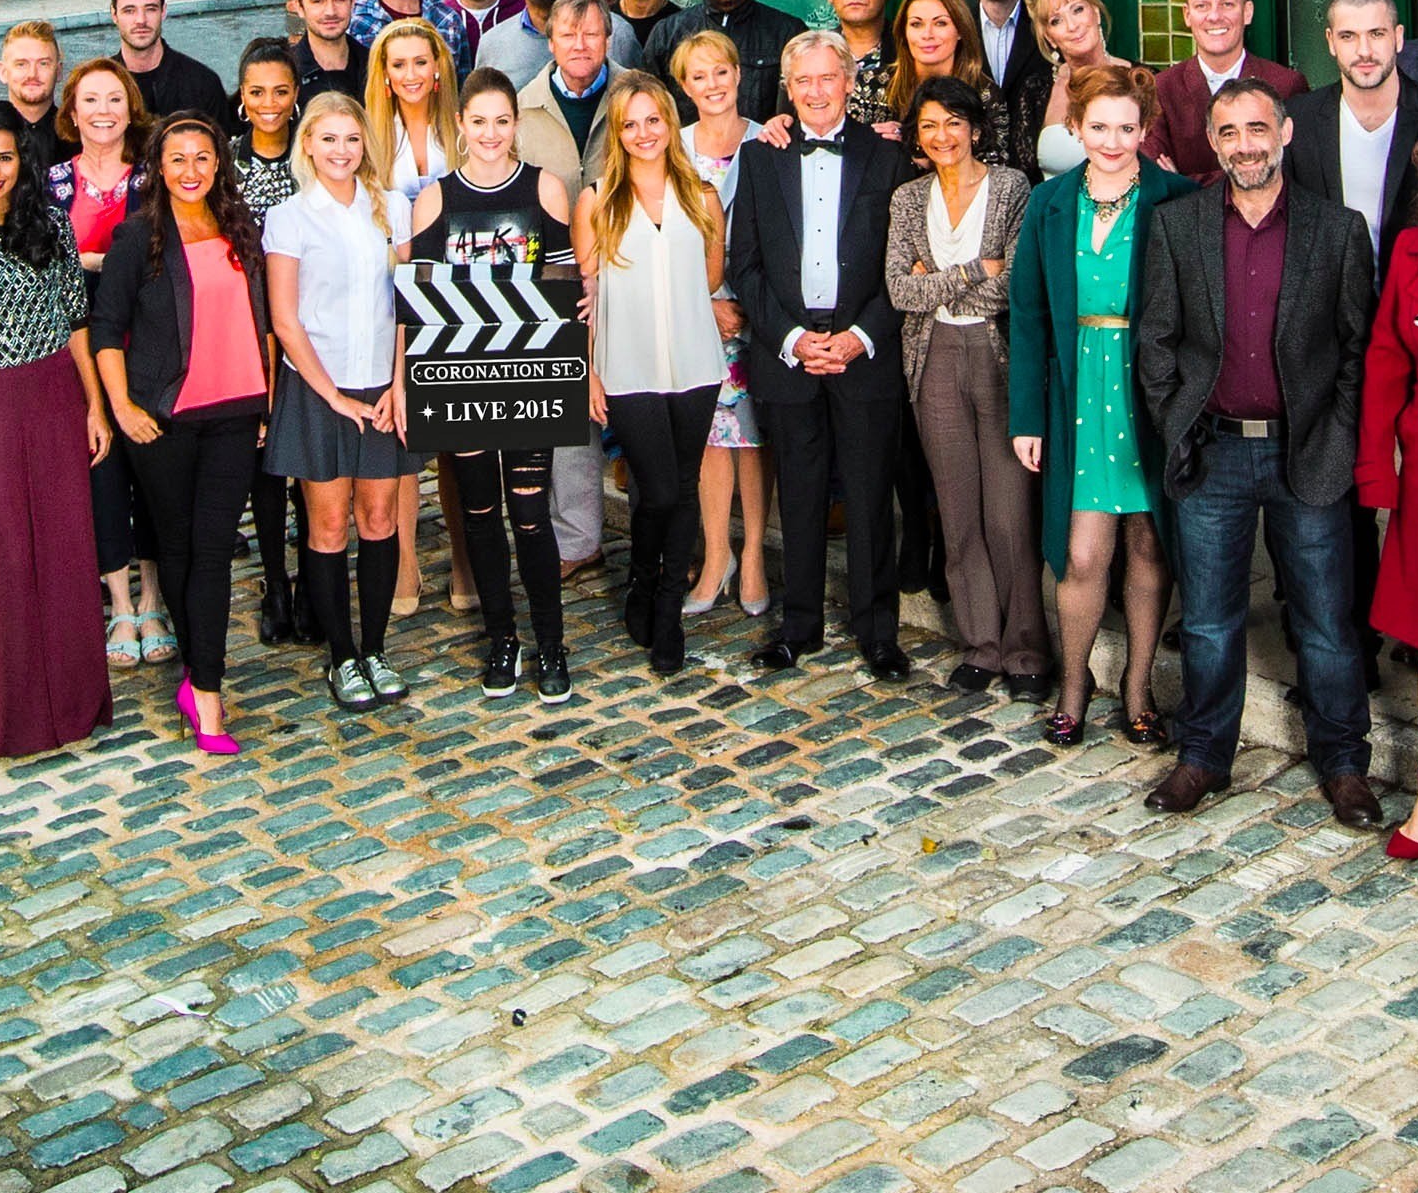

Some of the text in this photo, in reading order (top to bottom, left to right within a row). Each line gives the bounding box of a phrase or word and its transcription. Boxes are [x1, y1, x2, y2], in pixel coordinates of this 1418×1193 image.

[423, 363, 573, 381] CORONATION ST.
[445, 399, 564, 423] LIVE 2015
